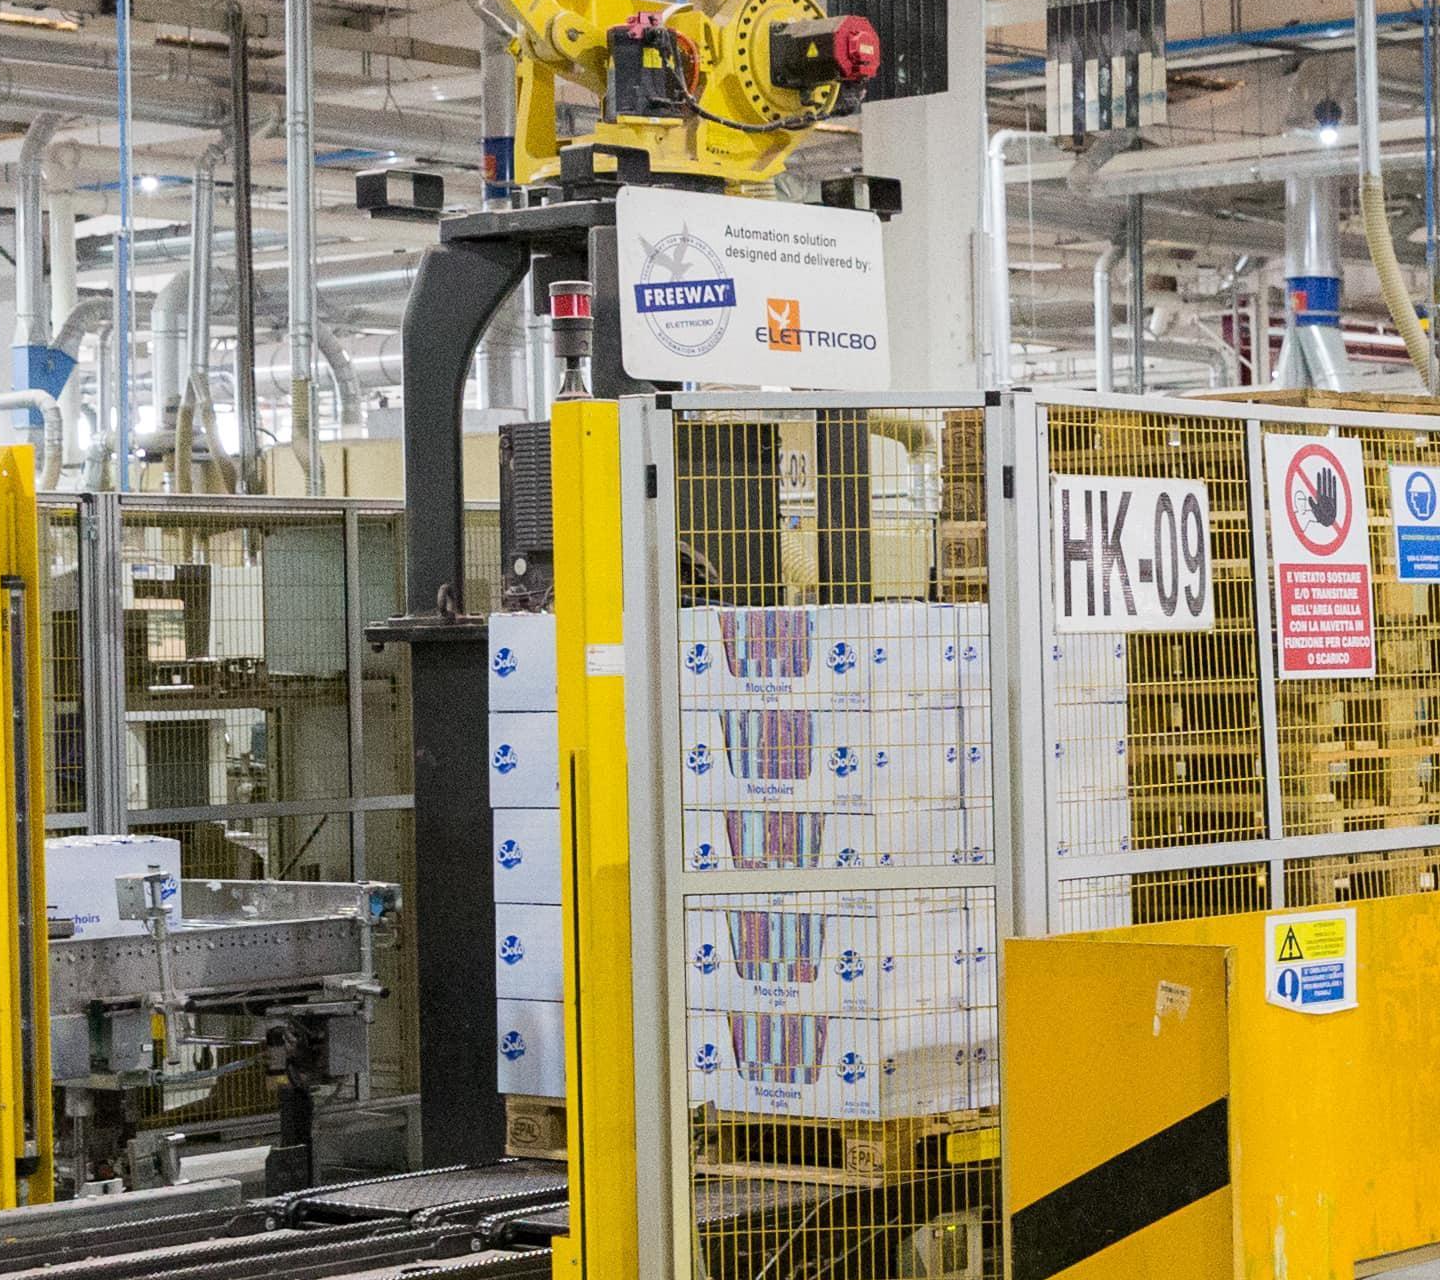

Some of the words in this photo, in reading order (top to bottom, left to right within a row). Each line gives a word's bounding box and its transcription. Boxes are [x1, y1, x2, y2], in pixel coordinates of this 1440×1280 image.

[725, 225, 790, 243] Automation
[793, 232, 837, 248] solution
[725, 247, 777, 264] designed
[780, 249, 801, 264] and
[804, 253, 853, 269] delivered
[855, 256, 872, 273] by:
[644, 284, 725, 307] FREEWAY
[755, 326, 877, 351] ELETTRIC80
[1061, 489, 1207, 617] HK-09
[1294, 571, 1326, 583] VIETATO
[1326, 572, 1361, 584] SOSTARE
[1294, 587, 1310, 600] E/O
[1311, 587, 1359, 600] TRANSITARE
[1291, 603, 1334, 616] NELL'AREA
[1334, 603, 1362, 616] GIALLA
[1289, 620, 1308, 632] CON
[1308, 620, 1320, 632] LA
[1320, 620, 1354, 632] NAVETTA
[1284, 636, 1324, 649] FUNZIONE
[1325, 636, 1341, 648] PER
[1341, 635, 1371, 648] CARICO
[491, 649, 518, 672] Solo
[1307, 652, 1315, 665] O
[1315, 652, 1350, 665] SCARICO
[492, 746, 518, 768] Solo
[497, 841, 523, 863] Solo
[499, 937, 525, 959] Solo
[500, 1033, 526, 1054] Solo
[514, 1121, 537, 1139] EPAL
